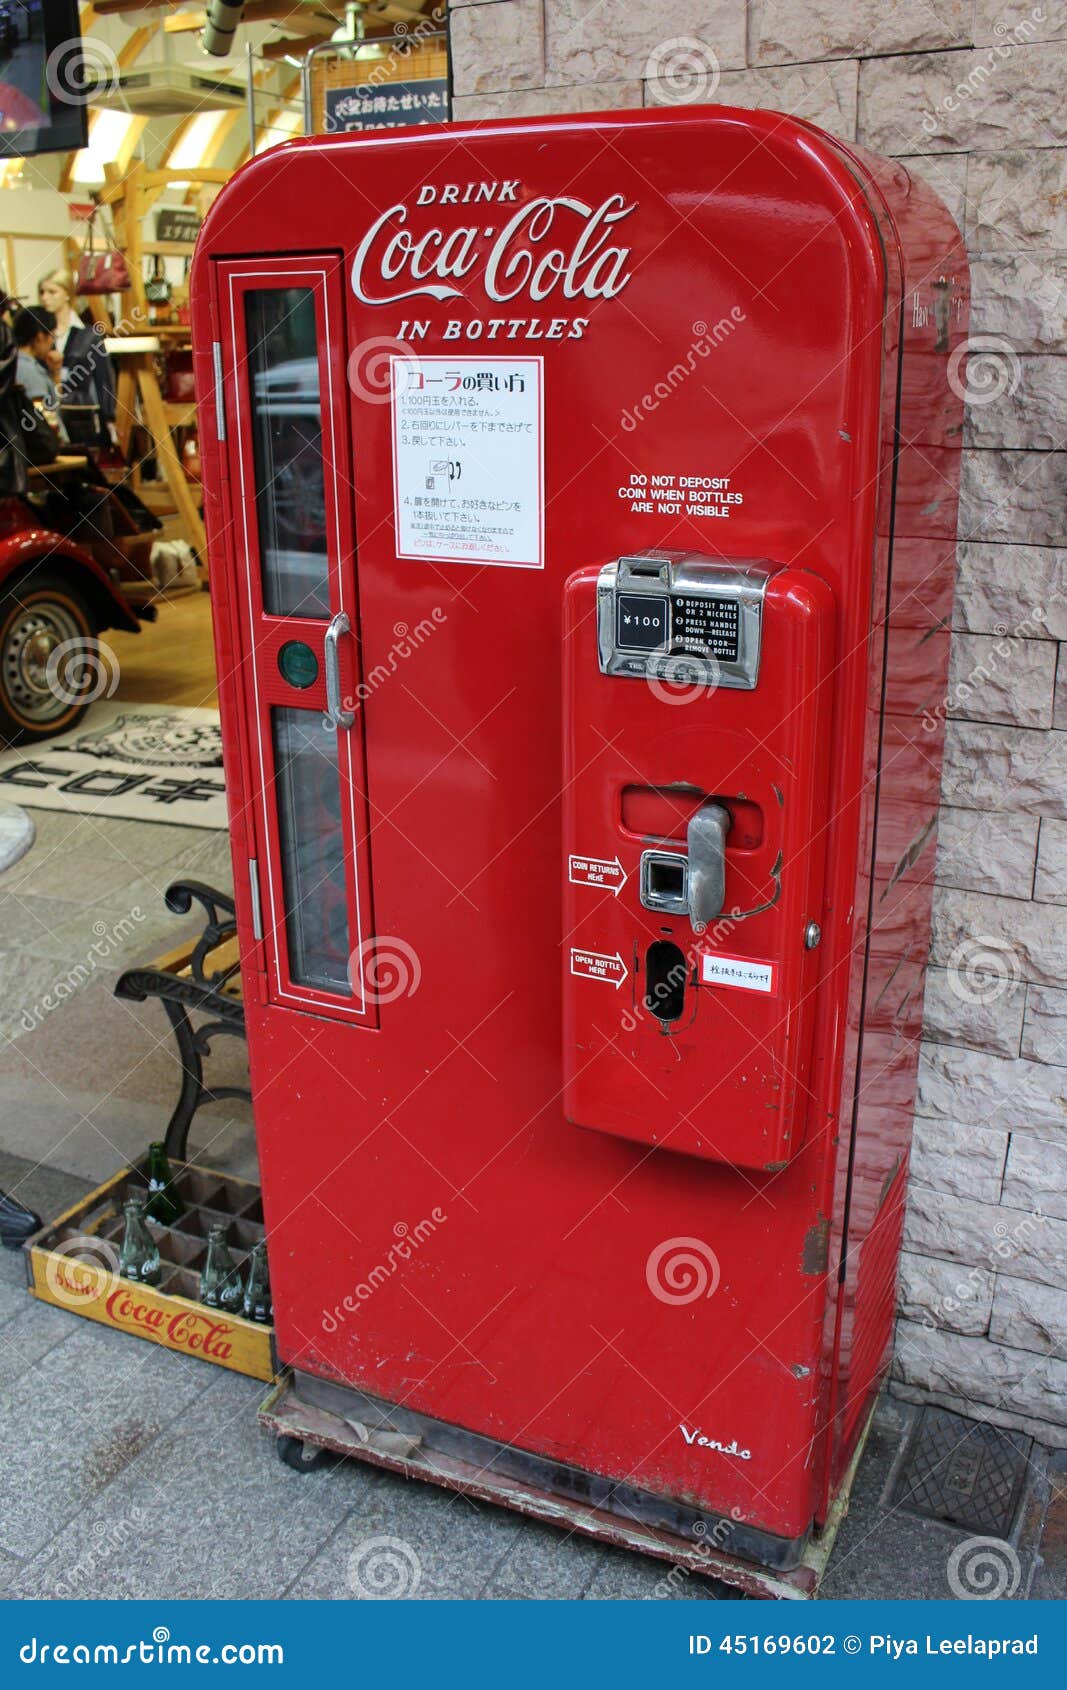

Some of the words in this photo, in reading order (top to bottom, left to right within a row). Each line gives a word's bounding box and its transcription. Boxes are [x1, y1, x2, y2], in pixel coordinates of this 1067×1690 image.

[416, 180, 521, 205] DRINK
[396, 320, 432, 341] IN
[442, 318, 590, 341] BOTTLES
[407, 371, 526, 393] コーラの買い方
[630, 474, 648, 486] DO
[651, 475, 675, 487] NOT
[679, 476, 731, 490] DEPOSIT
[618, 487, 647, 499] COIN
[650, 489, 685, 501] WHEN
[689, 491, 743, 504] BOTTLES
[631, 501, 654, 513] ARE
[658, 503, 681, 514] NOT
[686, 505, 730, 518] VISIBLE
[686, 600, 716, 611] DEPOSIT
[719, 601, 738, 611] DIME
[623, 614, 661, 628] ¥100
[686, 608, 697, 616] OR
[699, 609, 704, 617] 2
[706, 610, 738, 620] NICKELS
[685, 618, 707, 627] PRESS
[709, 620, 738, 630] HANDLE
[684, 636, 705, 646] OPEN
[684, 644, 710, 654] REMOVE
[713, 647, 737, 657] BOTTLE
[572, 861, 588, 871] COIN
[589, 862, 620, 876] RETURNS
[575, 954, 594, 966] OPEN
[595, 958, 622, 972] BOTTLE
[588, 966, 608, 977] HERE
[679, 1423, 752, 1460] Vendo
